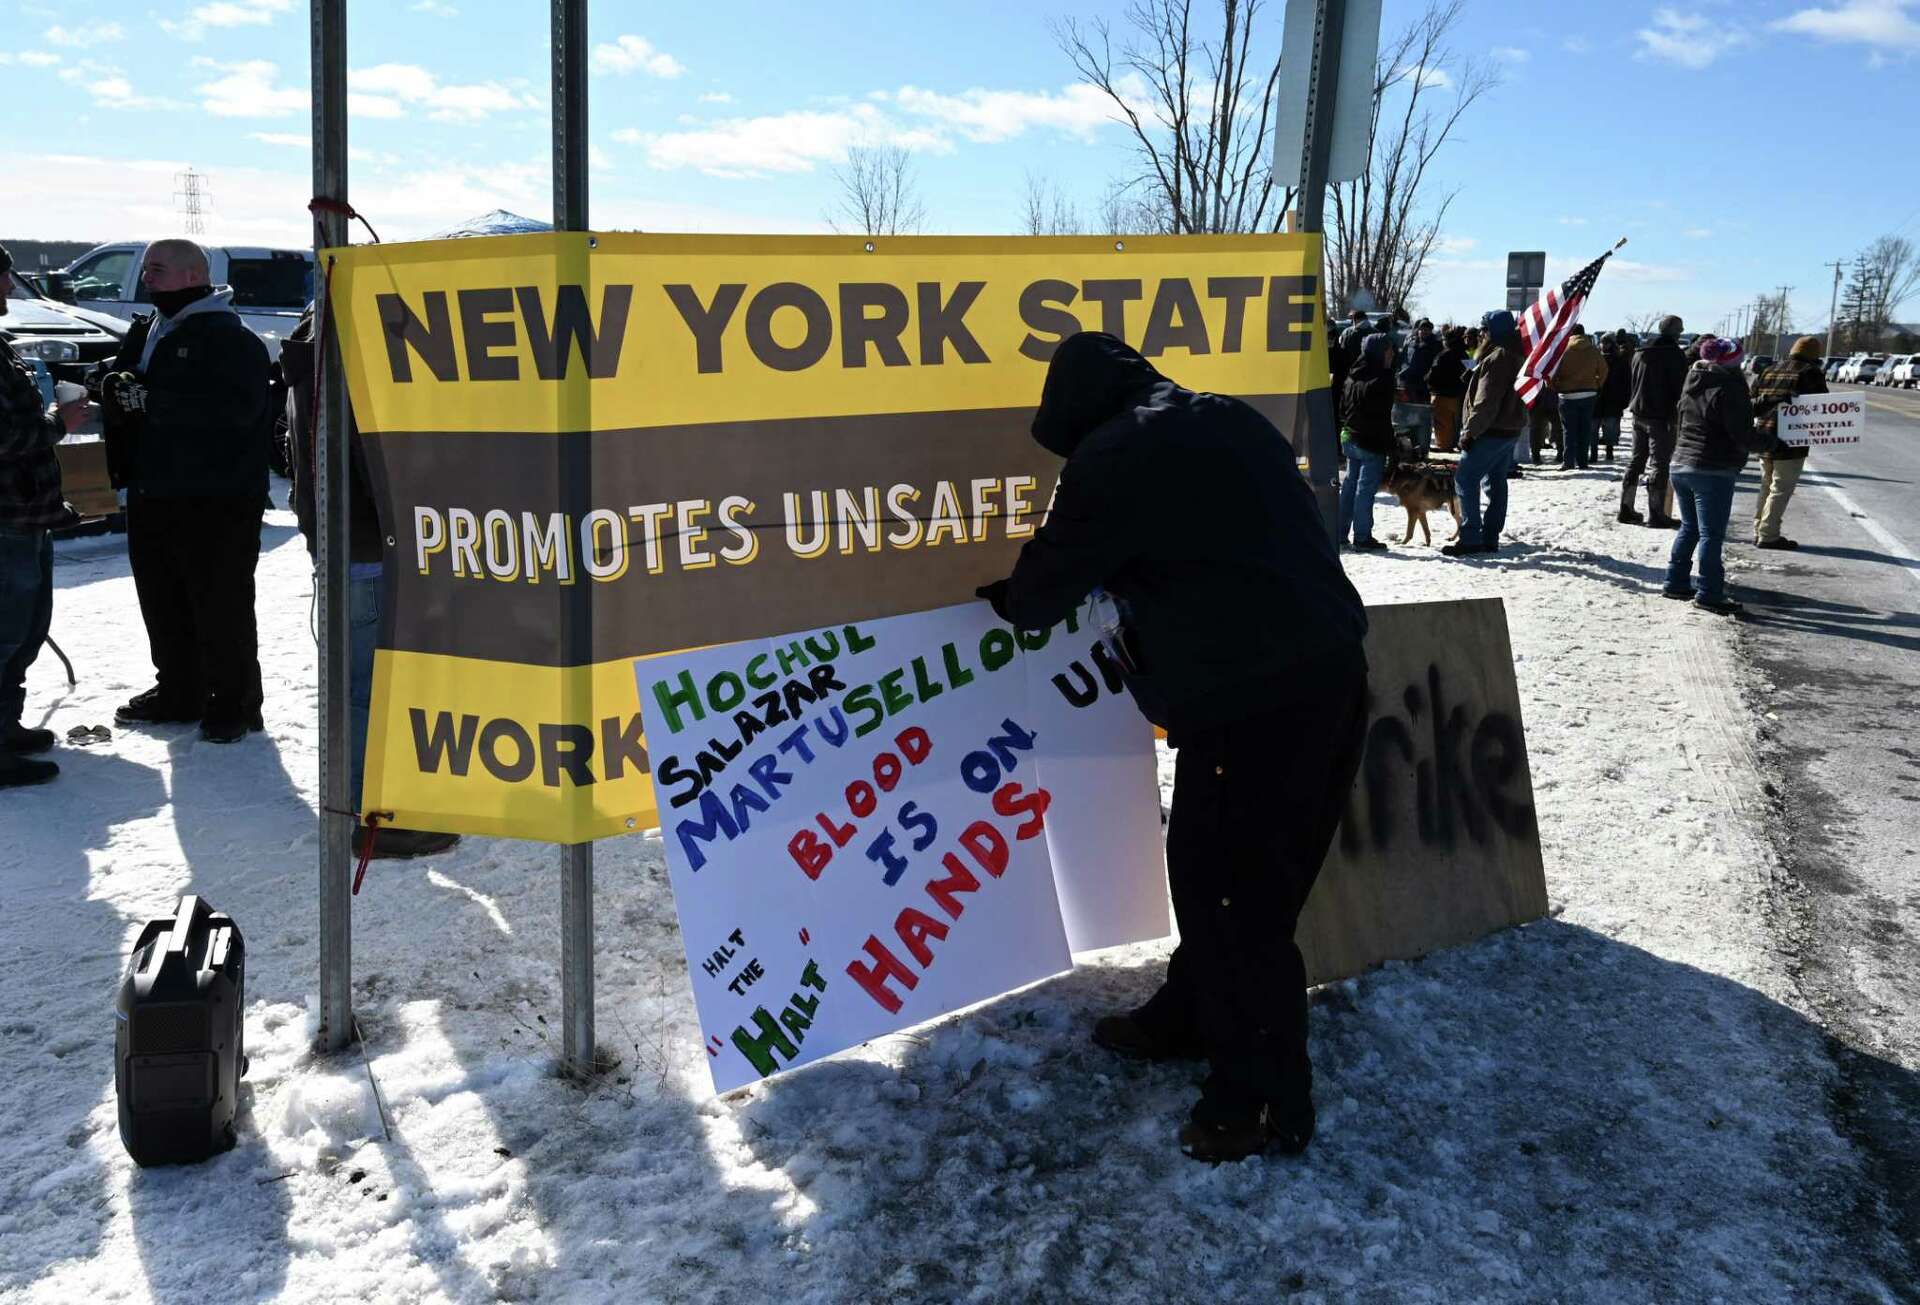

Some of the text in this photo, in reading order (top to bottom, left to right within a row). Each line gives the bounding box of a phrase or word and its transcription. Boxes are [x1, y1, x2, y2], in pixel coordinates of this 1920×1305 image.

[376, 275, 1318, 383] NEW YORK STATE
[1781, 404, 1810, 416] 70%
[1821, 402, 1860, 414] 100%
[1785, 436, 1860, 446] XPENDABLE
[1788, 420, 1854, 430] ESSENTIAL
[414, 495, 759, 585] PROMOTES
[783, 475, 1037, 561] UNSAFE
[652, 625, 875, 734] HOCHUL
[658, 664, 847, 808] SALAZAR
[787, 726, 933, 881] BLOOD
[866, 800, 938, 887] IS
[960, 718, 1038, 794] ON
[846, 782, 1051, 1015] HANDS
[702, 928, 745, 978] HALT
[728, 957, 765, 996] THE
